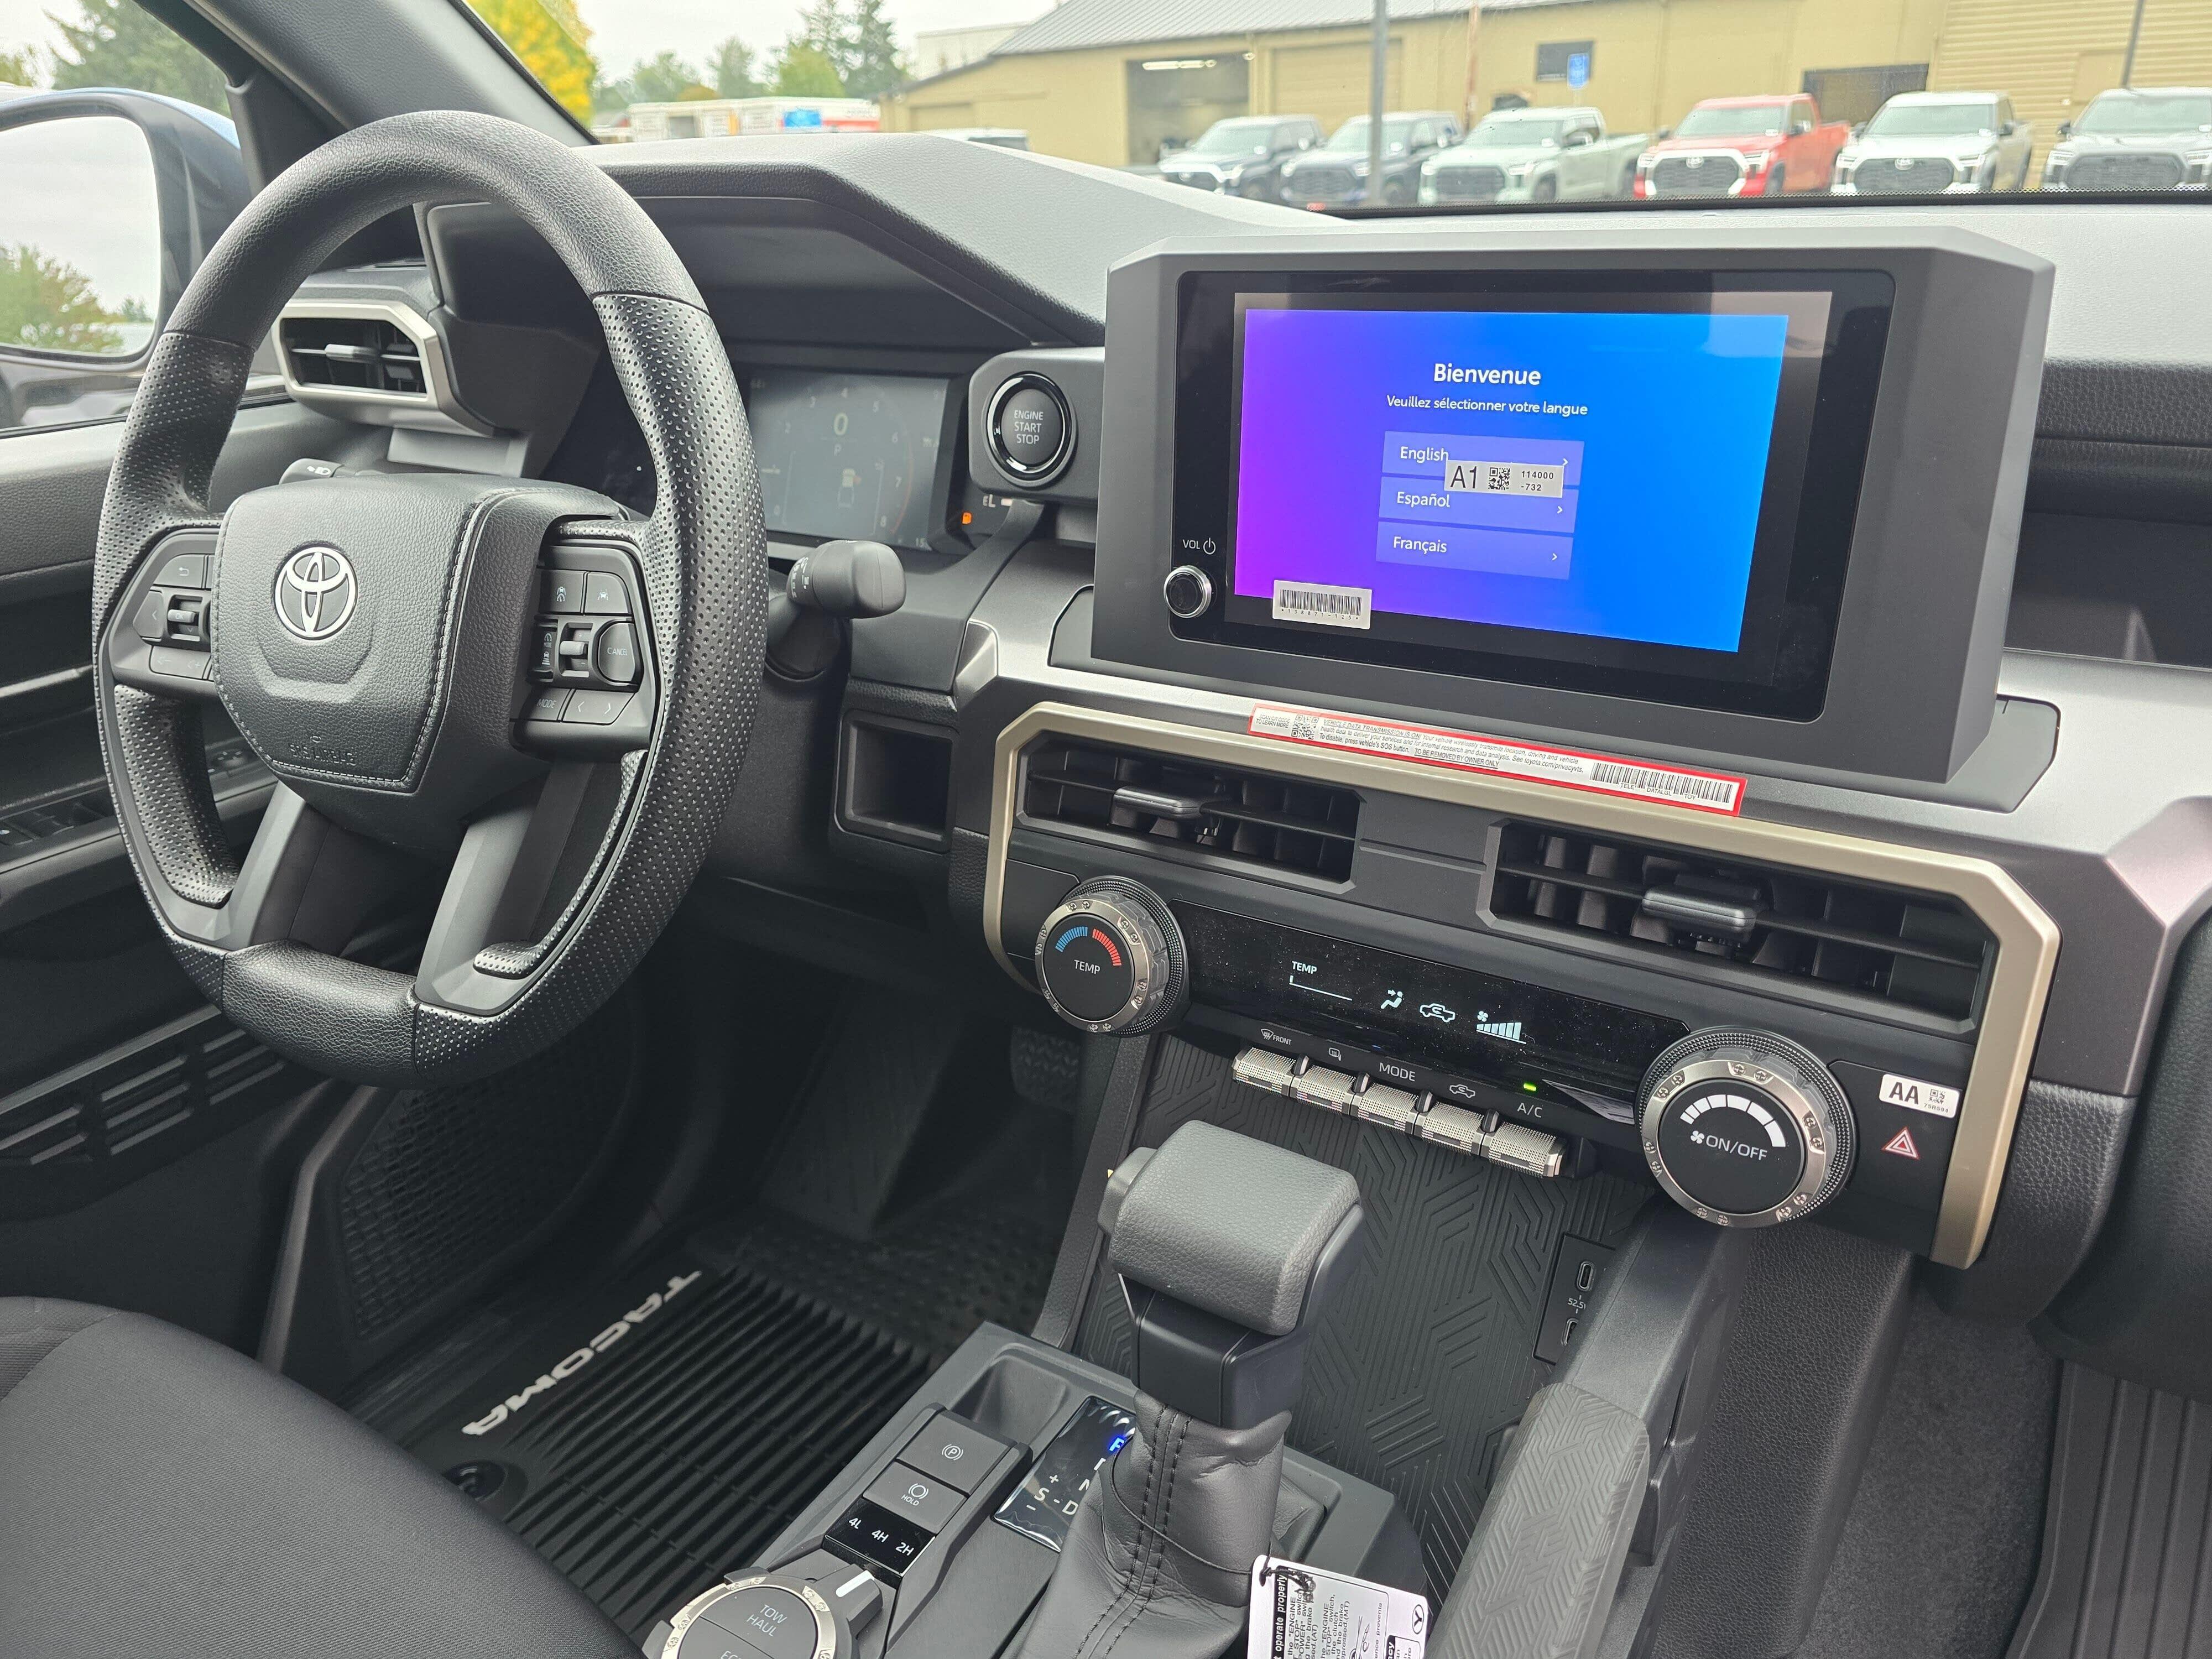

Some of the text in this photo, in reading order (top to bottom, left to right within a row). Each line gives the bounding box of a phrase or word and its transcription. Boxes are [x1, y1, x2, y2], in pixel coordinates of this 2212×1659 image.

[1433, 363, 1542, 385] Bienvenue
[1014, 409, 1044, 421] ENGINE
[1386, 395, 1588, 418] Veuillez sélectionner votre langue
[833, 413, 849, 435] 0
[1014, 421, 1041, 433] START
[1016, 434, 1040, 445] STOP
[1400, 446, 1449, 463] English
[1450, 465, 1477, 488] A1
[1521, 471, 1554, 479] 114000
[1397, 491, 1450, 508] Español
[1182, 539, 1201, 550] VOL
[1393, 536, 1447, 555] Français
[607, 647, 628, 656] CANCEL
[536, 698, 556, 709] MODE
[1326, 734, 1344, 743] disable,
[1359, 739, 1380, 749] vehicle's
[1393, 745, 1410, 753] button.
[1430, 750, 1456, 761] REMOVED
[1464, 756, 1485, 765] OWNER
[1485, 759, 1500, 768] ONLY
[1362, 725, 1404, 736] TRANSMISSION
[1528, 752, 1546, 760] driving
[1559, 756, 1579, 764] vehicle
[1421, 741, 1441, 749] internal
[1441, 744, 1464, 753] research
[1488, 752, 1510, 761] analysis.
[1074, 959, 1101, 975] TEMP
[1291, 961, 1317, 974] TEMP
[1272, 1035, 1292, 1046] FRONT
[1379, 1062, 1416, 1082] MODE
[1888, 1081, 1919, 1105] AA
[1517, 1102, 1543, 1118] A/C
[1705, 1135, 1768, 1161] ON/OFF
[462, 1271, 702, 1436] TACOMA
[901, 1494, 920, 1506] HOLD
[1062, 1500, 1078, 1515] D
[848, 1518, 914, 1556] 4L 4H 2H
[1276, 1574, 1287, 1613] properly
[759, 1604, 787, 1624] TOW
[747, 1614, 778, 1637] HAUL
[1275, 1616, 1284, 1652] operate
